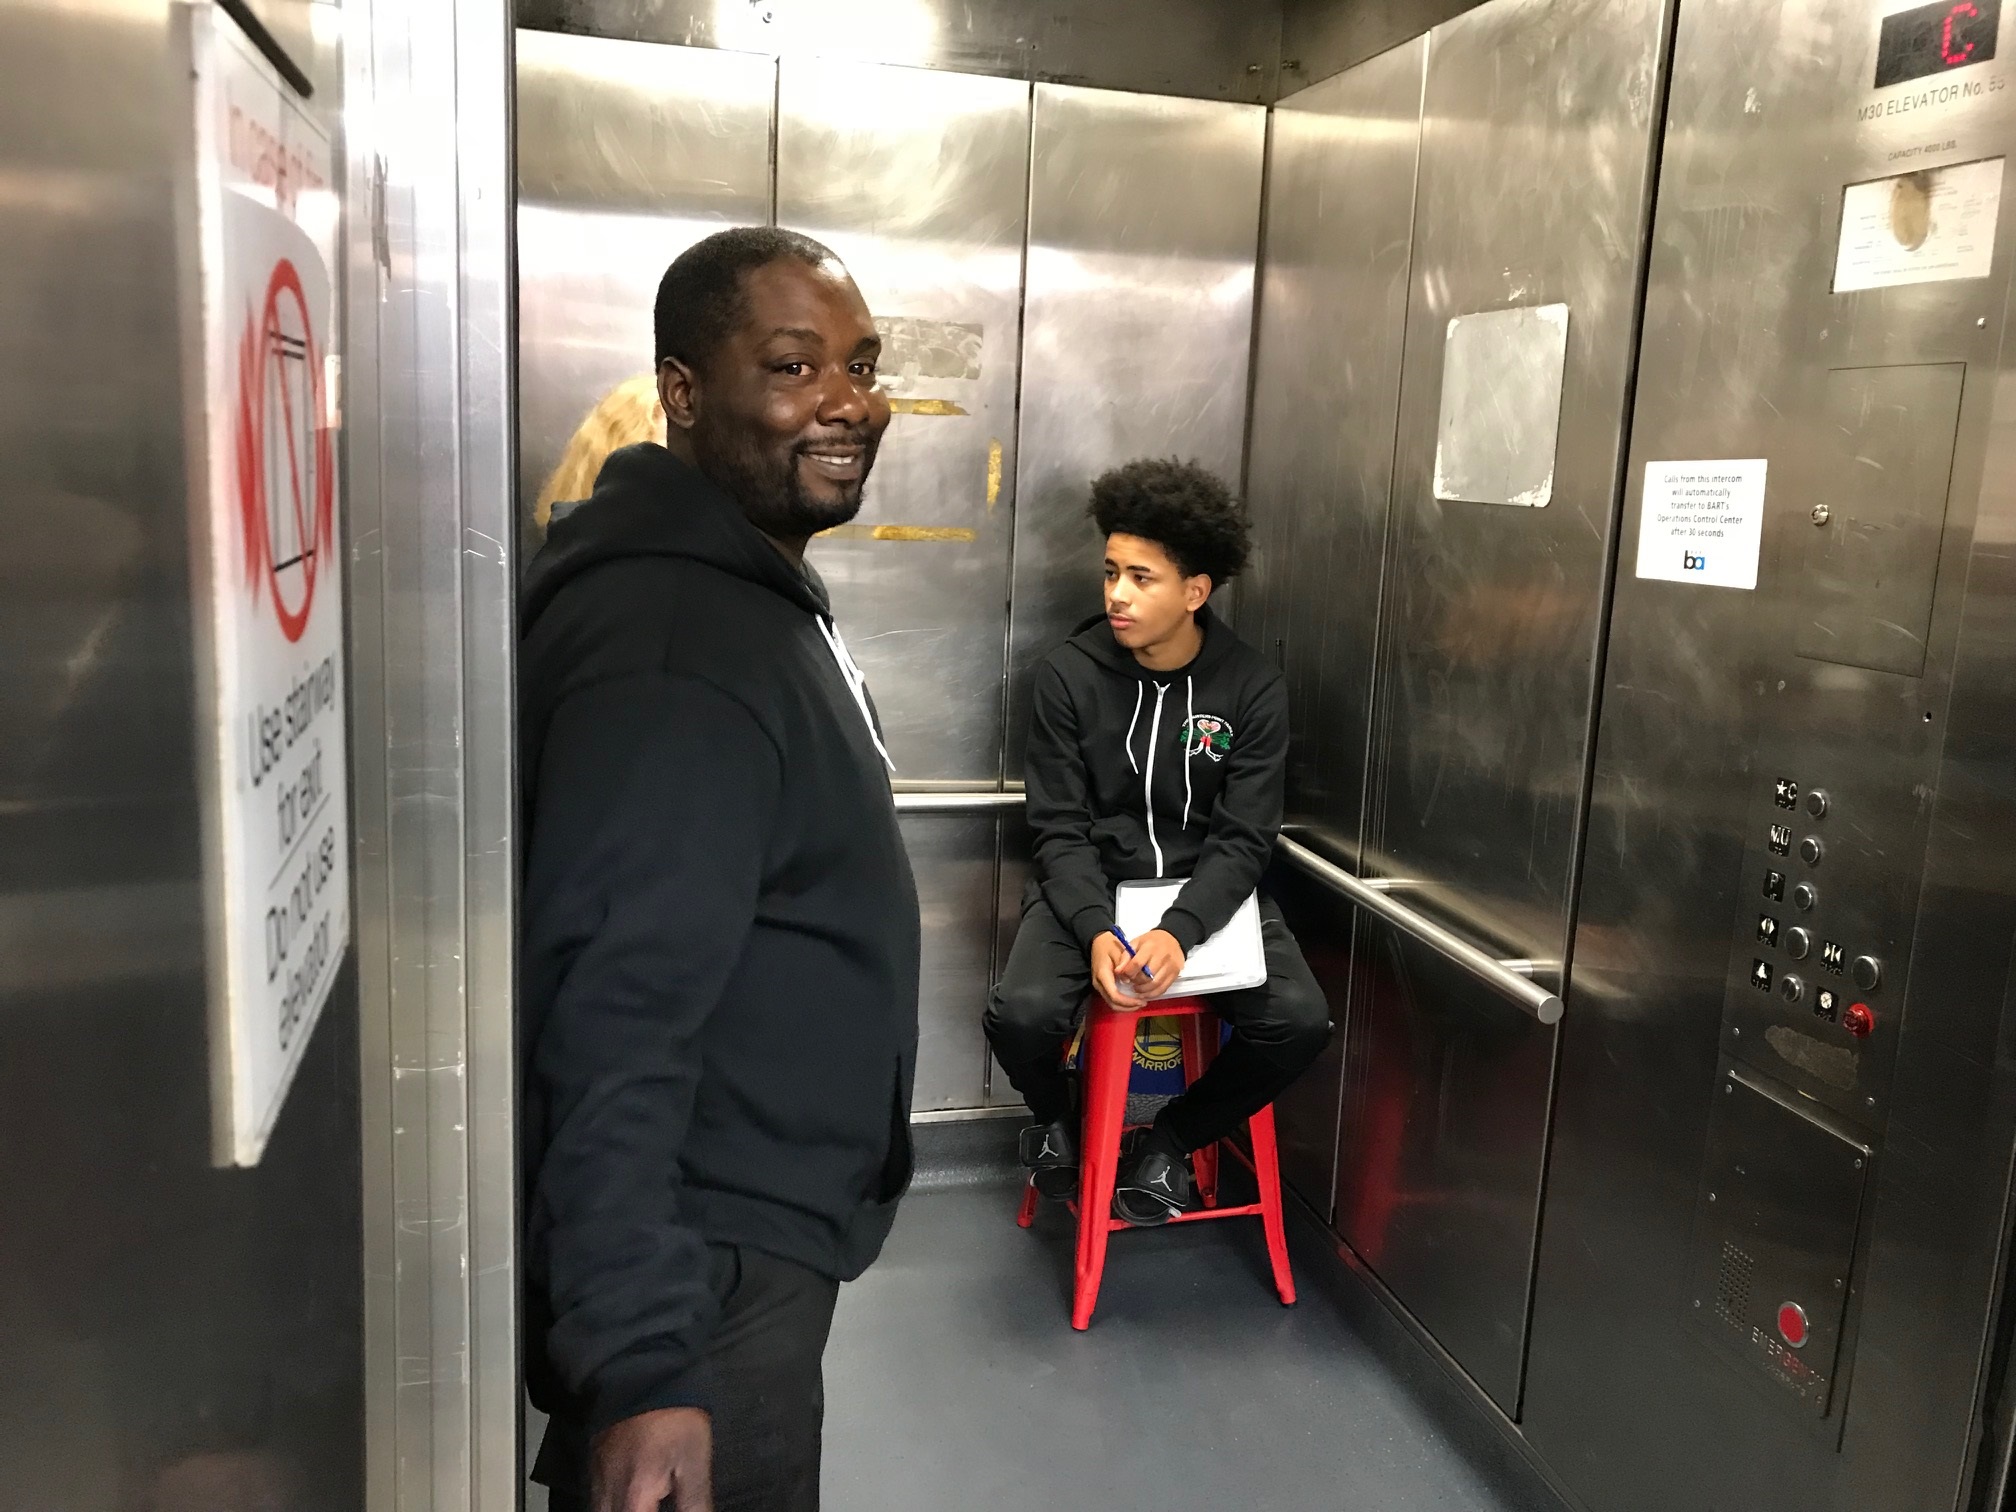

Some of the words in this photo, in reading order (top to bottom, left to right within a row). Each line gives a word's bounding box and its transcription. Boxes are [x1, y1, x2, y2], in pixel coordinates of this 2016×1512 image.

[1941, 2, 1978, 64] C
[1857, 103, 1883, 121] M30
[1886, 84, 1959, 116] ELEVATOR
[1962, 81, 1984, 98] No.
[1888, 146, 1922, 161] CAPACITY
[1664, 475, 1679, 483] Calls
[1681, 474, 1696, 483] from
[1698, 475, 1710, 483] this
[1712, 475, 1742, 483] intercom
[1672, 488, 1683, 496] will
[1685, 488, 1731, 499] automatically
[1671, 501, 1696, 510] transfer
[1698, 502, 1706, 510] to
[1707, 501, 1730, 511] BART's
[1657, 514, 1692, 523] Operations
[1693, 515, 1718, 523] Control
[1720, 515, 1743, 524] Center
[1671, 527, 1687, 536] after
[1689, 528, 1696, 536] 30
[249, 703, 282, 788] Use
[285, 651, 335, 749] stairway
[276, 780, 298, 856] for
[300, 736, 323, 819] exit
[1770, 824, 1791, 846] MU
[1769, 872, 1781, 889] P
[265, 905, 288, 986] Do
[290, 849, 313, 942] not
[313, 825, 335, 894] use
